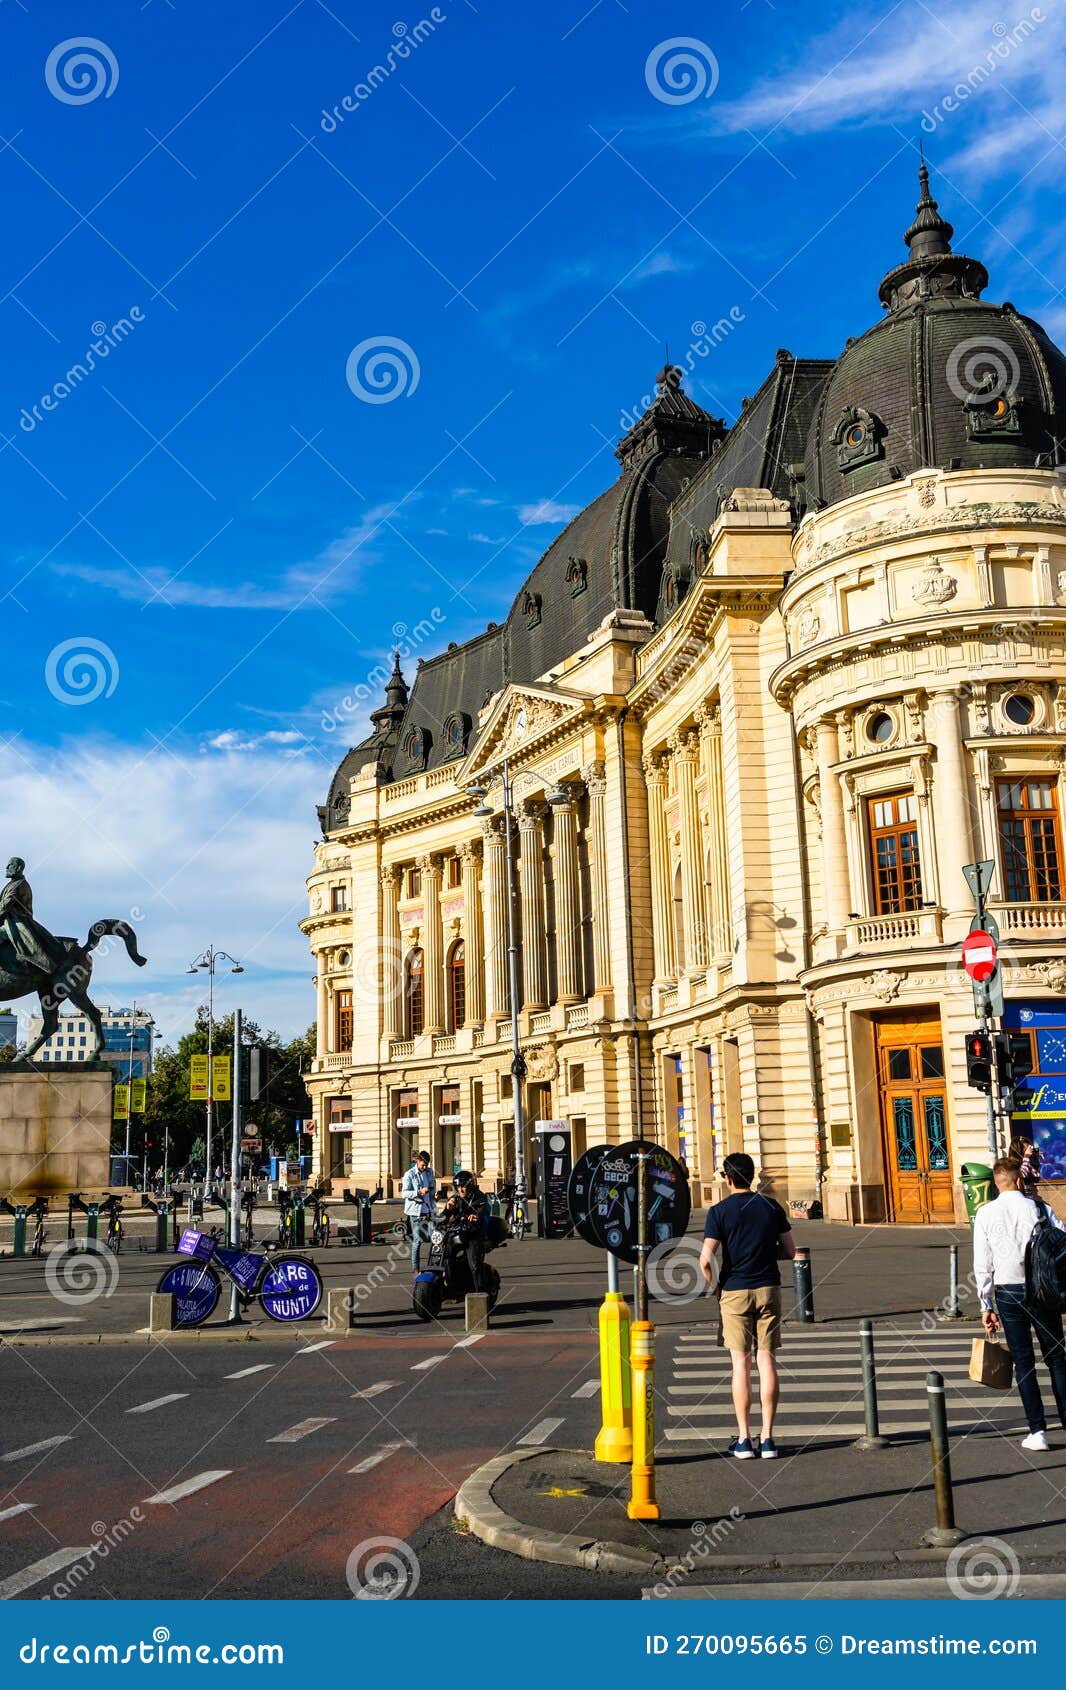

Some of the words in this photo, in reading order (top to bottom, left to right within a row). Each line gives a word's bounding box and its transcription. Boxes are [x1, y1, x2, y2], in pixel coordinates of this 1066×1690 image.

[269, 1265, 308, 1286] TARG
[298, 1283, 309, 1292] de
[272, 1295, 310, 1317] NUNTI
